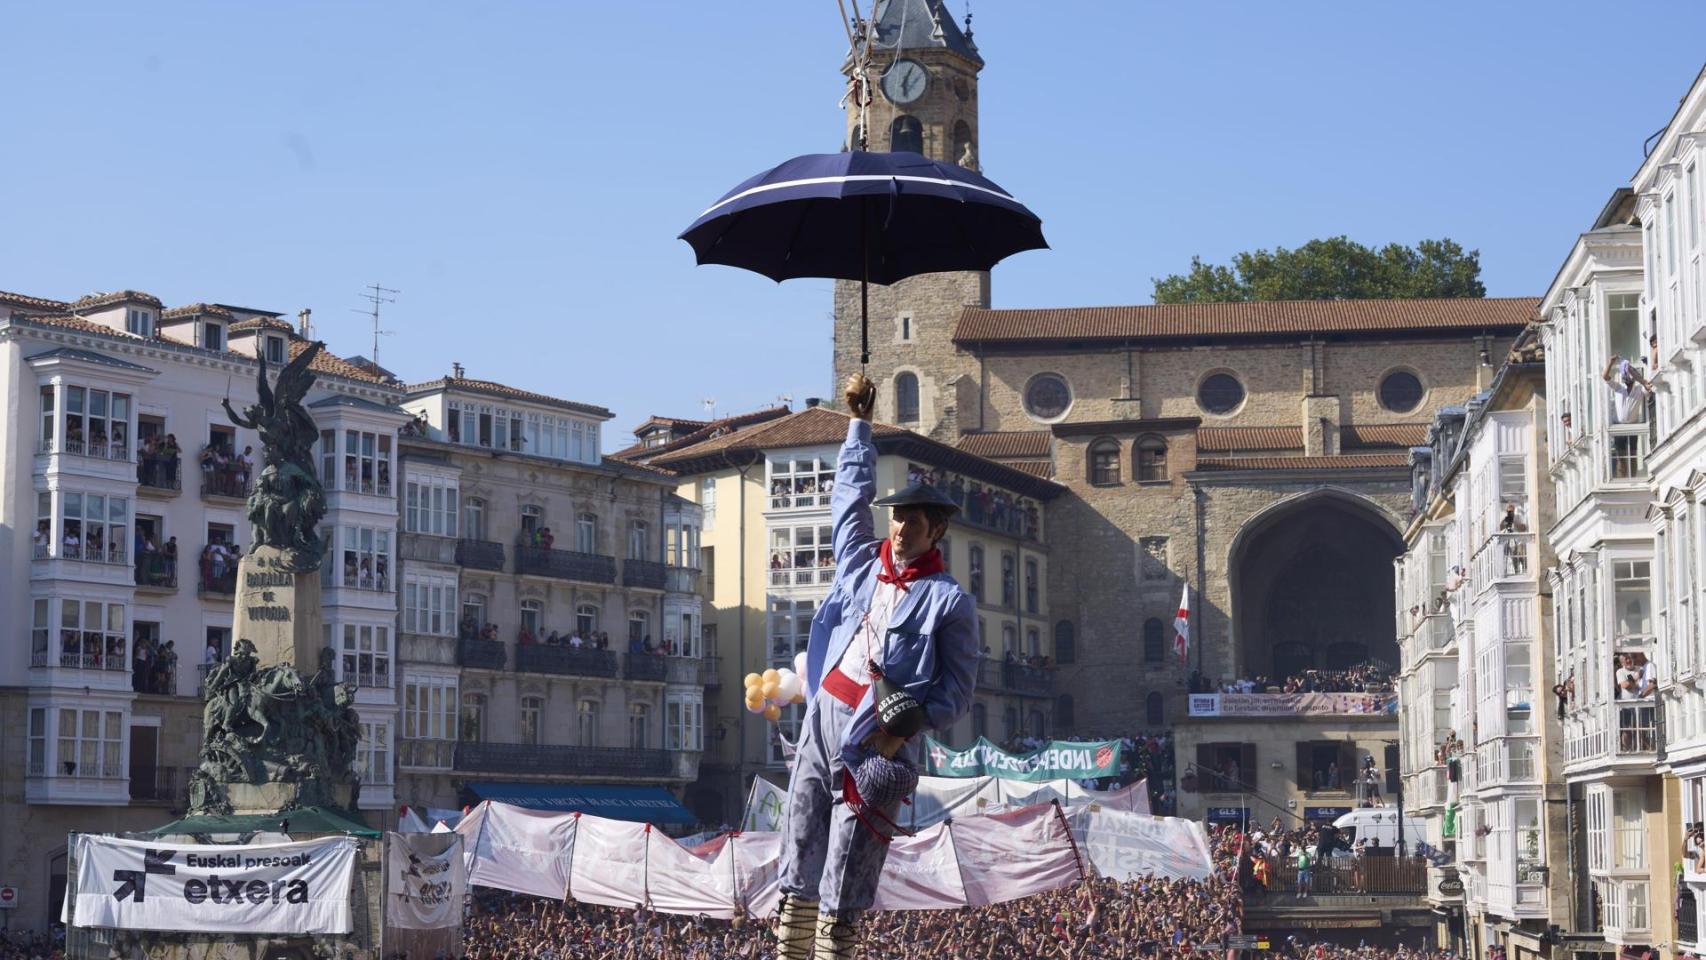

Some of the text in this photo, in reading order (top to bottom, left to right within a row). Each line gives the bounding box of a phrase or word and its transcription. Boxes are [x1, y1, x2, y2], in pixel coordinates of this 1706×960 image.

[247, 571, 294, 588] BATALLA
[263, 592, 275, 602] DE
[248, 605, 292, 622] VITORIA
[186, 852, 312, 870] Euskal presoak
[183, 874, 309, 905] etxera
